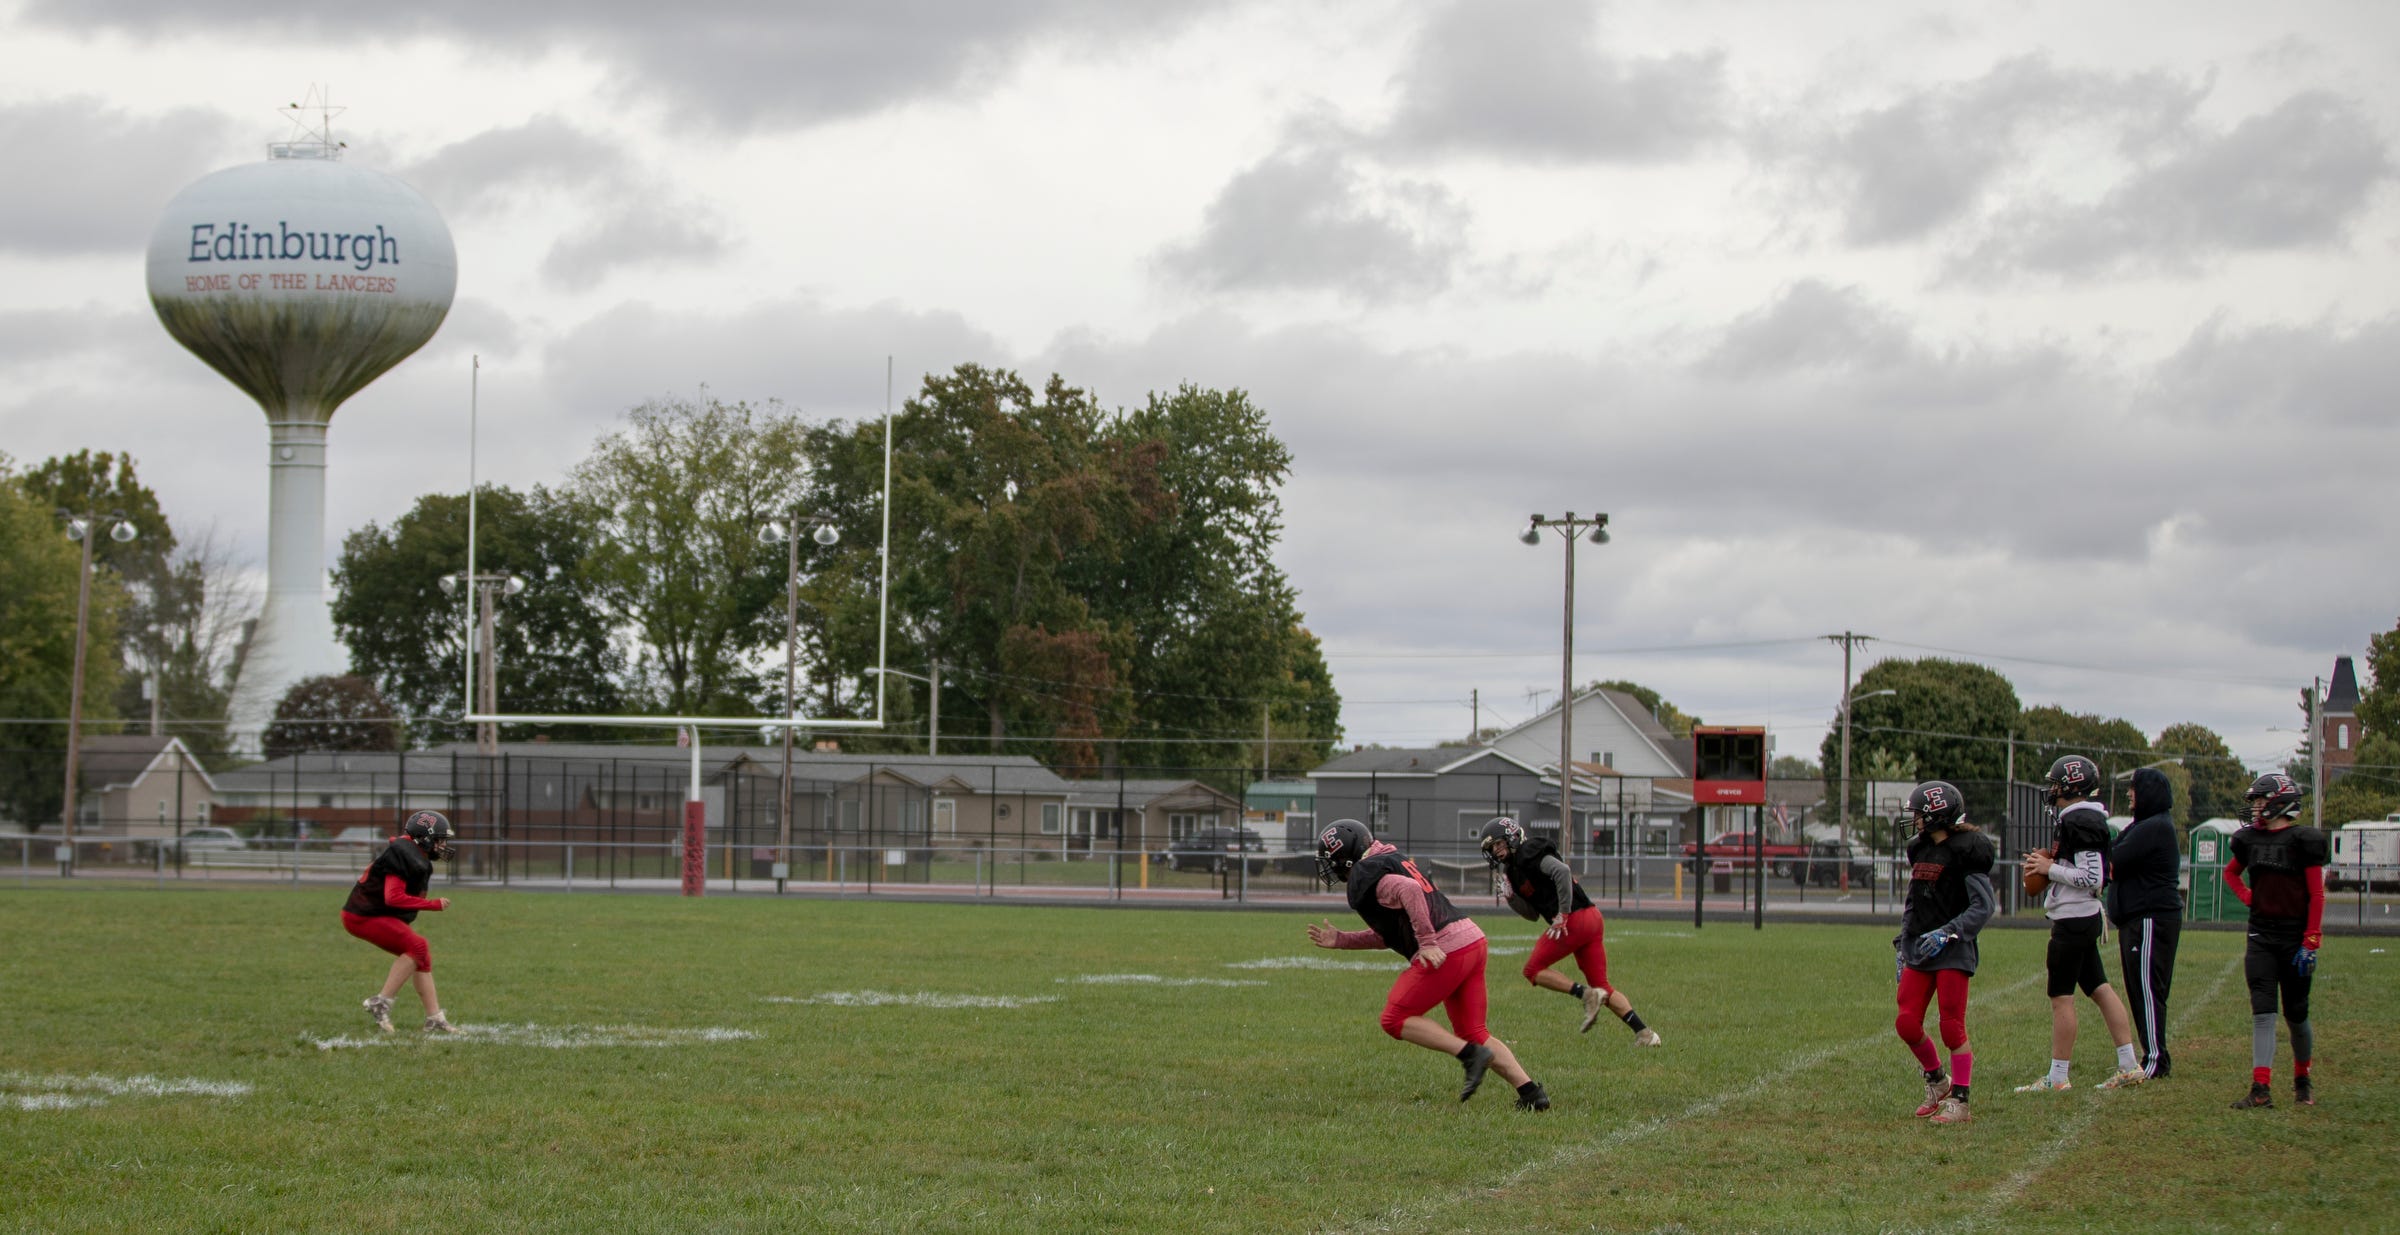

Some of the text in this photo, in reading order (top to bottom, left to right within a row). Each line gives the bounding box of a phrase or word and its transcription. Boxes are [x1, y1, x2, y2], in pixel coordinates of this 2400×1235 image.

[188, 221, 399, 271] Edinburgh
[186, 273, 397, 294] HOME OF THE LANCERS
[2063, 760, 2085, 784] E
[1923, 786, 1948, 812] E
[1321, 826, 1344, 855] E
